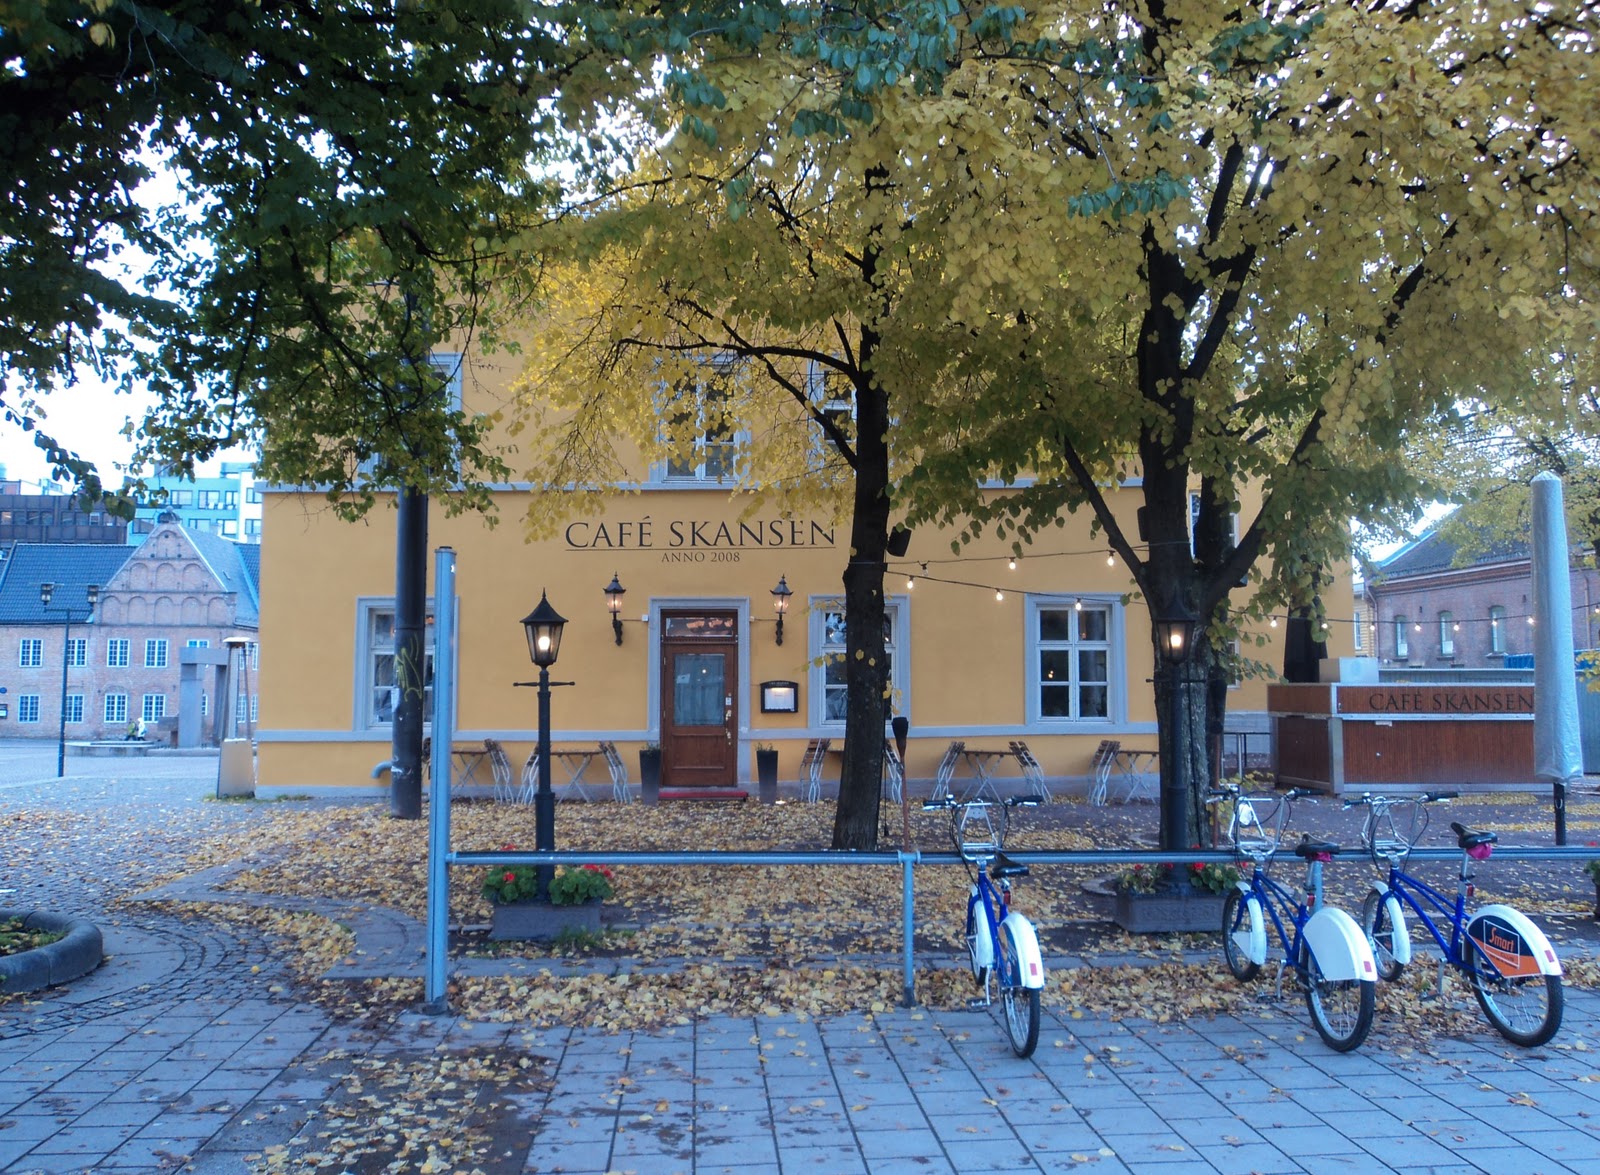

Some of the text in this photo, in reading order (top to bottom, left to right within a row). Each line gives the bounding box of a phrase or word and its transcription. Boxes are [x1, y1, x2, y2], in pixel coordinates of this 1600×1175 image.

[565, 515, 836, 548] CAFÉ SKANSEN
[661, 552, 740, 563] ANNO 2008
[1369, 690, 1534, 711] CAFÉ SKANSEN
[1489, 927, 1514, 952] Smart
